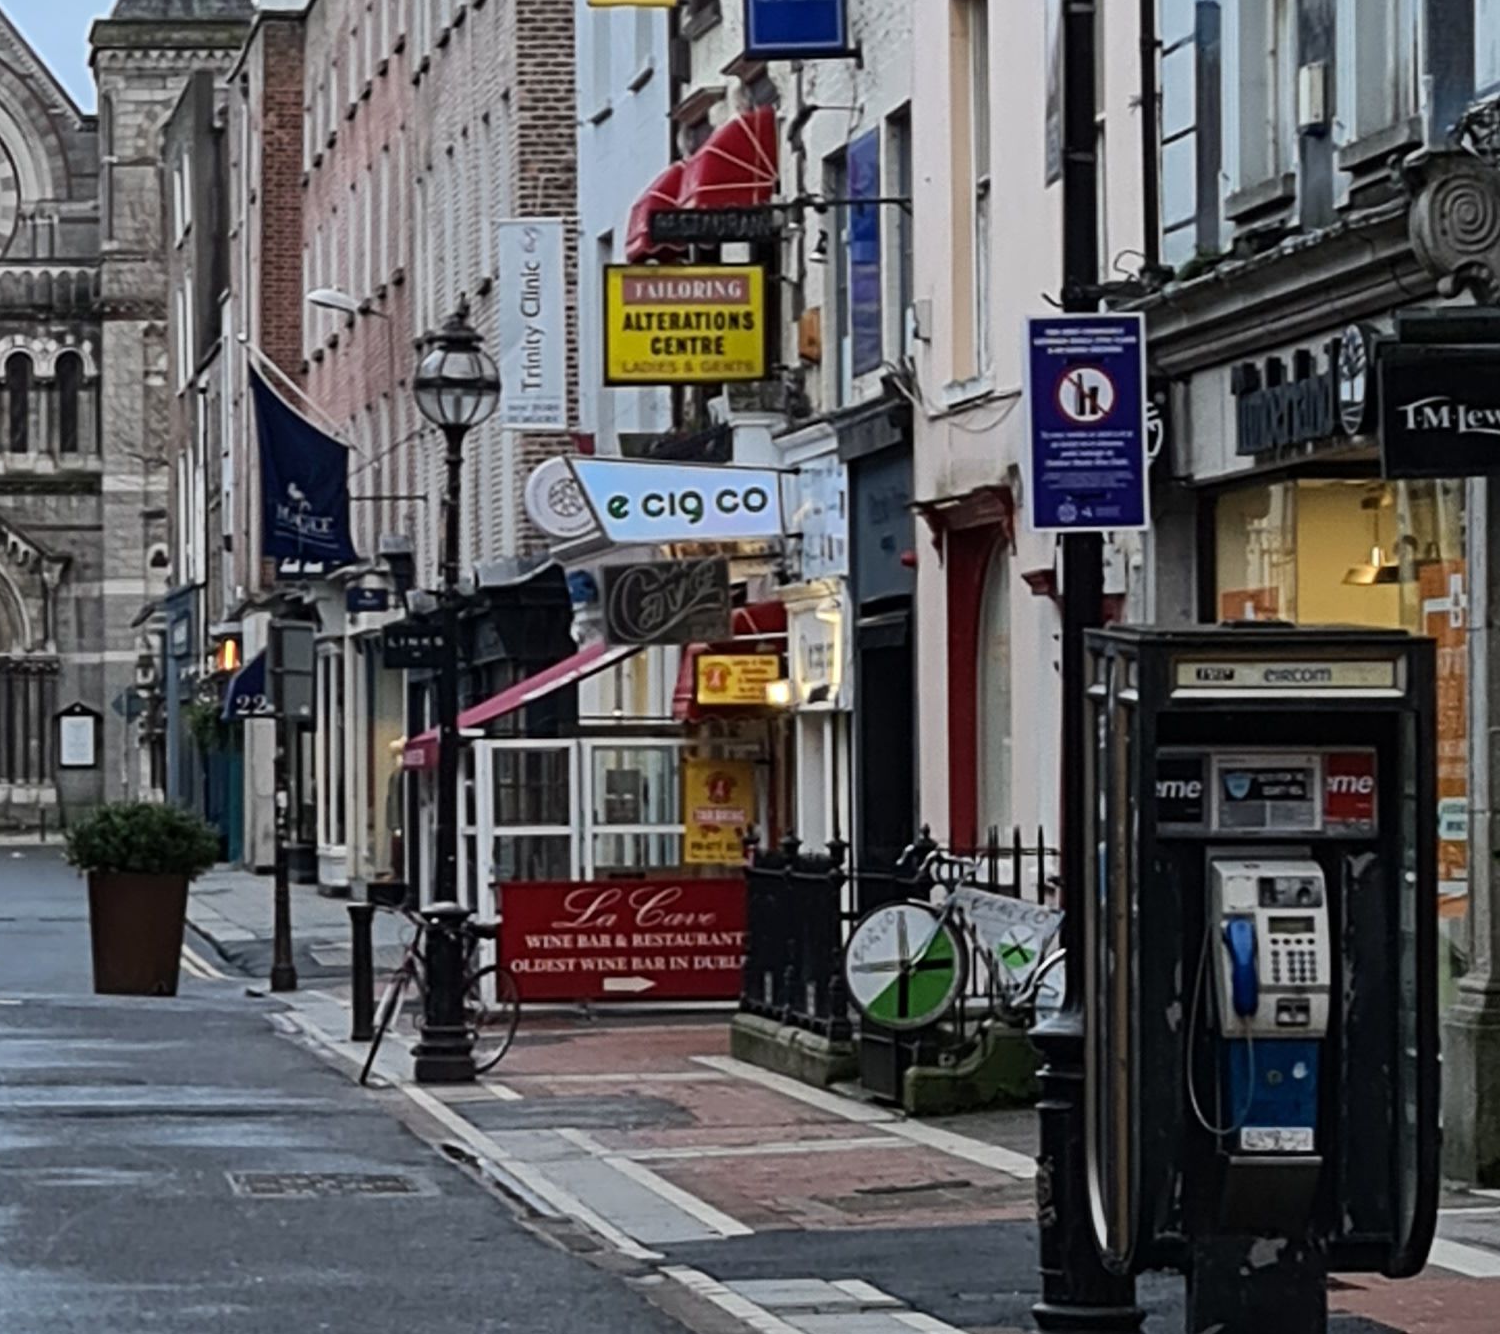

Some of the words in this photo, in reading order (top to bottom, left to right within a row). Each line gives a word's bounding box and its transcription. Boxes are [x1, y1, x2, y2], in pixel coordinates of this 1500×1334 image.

[520, 260, 541, 319] Clinic
[633, 279, 743, 299] TAILORING
[621, 310, 756, 332] ALTERATIONS
[650, 336, 726, 356] CENTRE
[521, 324, 546, 393] Trinity
[607, 494, 630, 519] e
[715, 486, 768, 514] co
[388, 636, 444, 646] LINKS
[1263, 667, 1332, 683] eircom
[551, 888, 622, 929] La
[628, 886, 717, 928] Cave
[525, 934, 573, 949] WINE
[577, 934, 612, 949] BAR
[615, 933, 629, 948] &
[632, 931, 745, 948] RESTAURANT
[511, 959, 576, 973] OLDEST
[579, 957, 628, 972] WINE
[631, 957, 666, 971] BAR
[669, 956, 689, 970] IN
